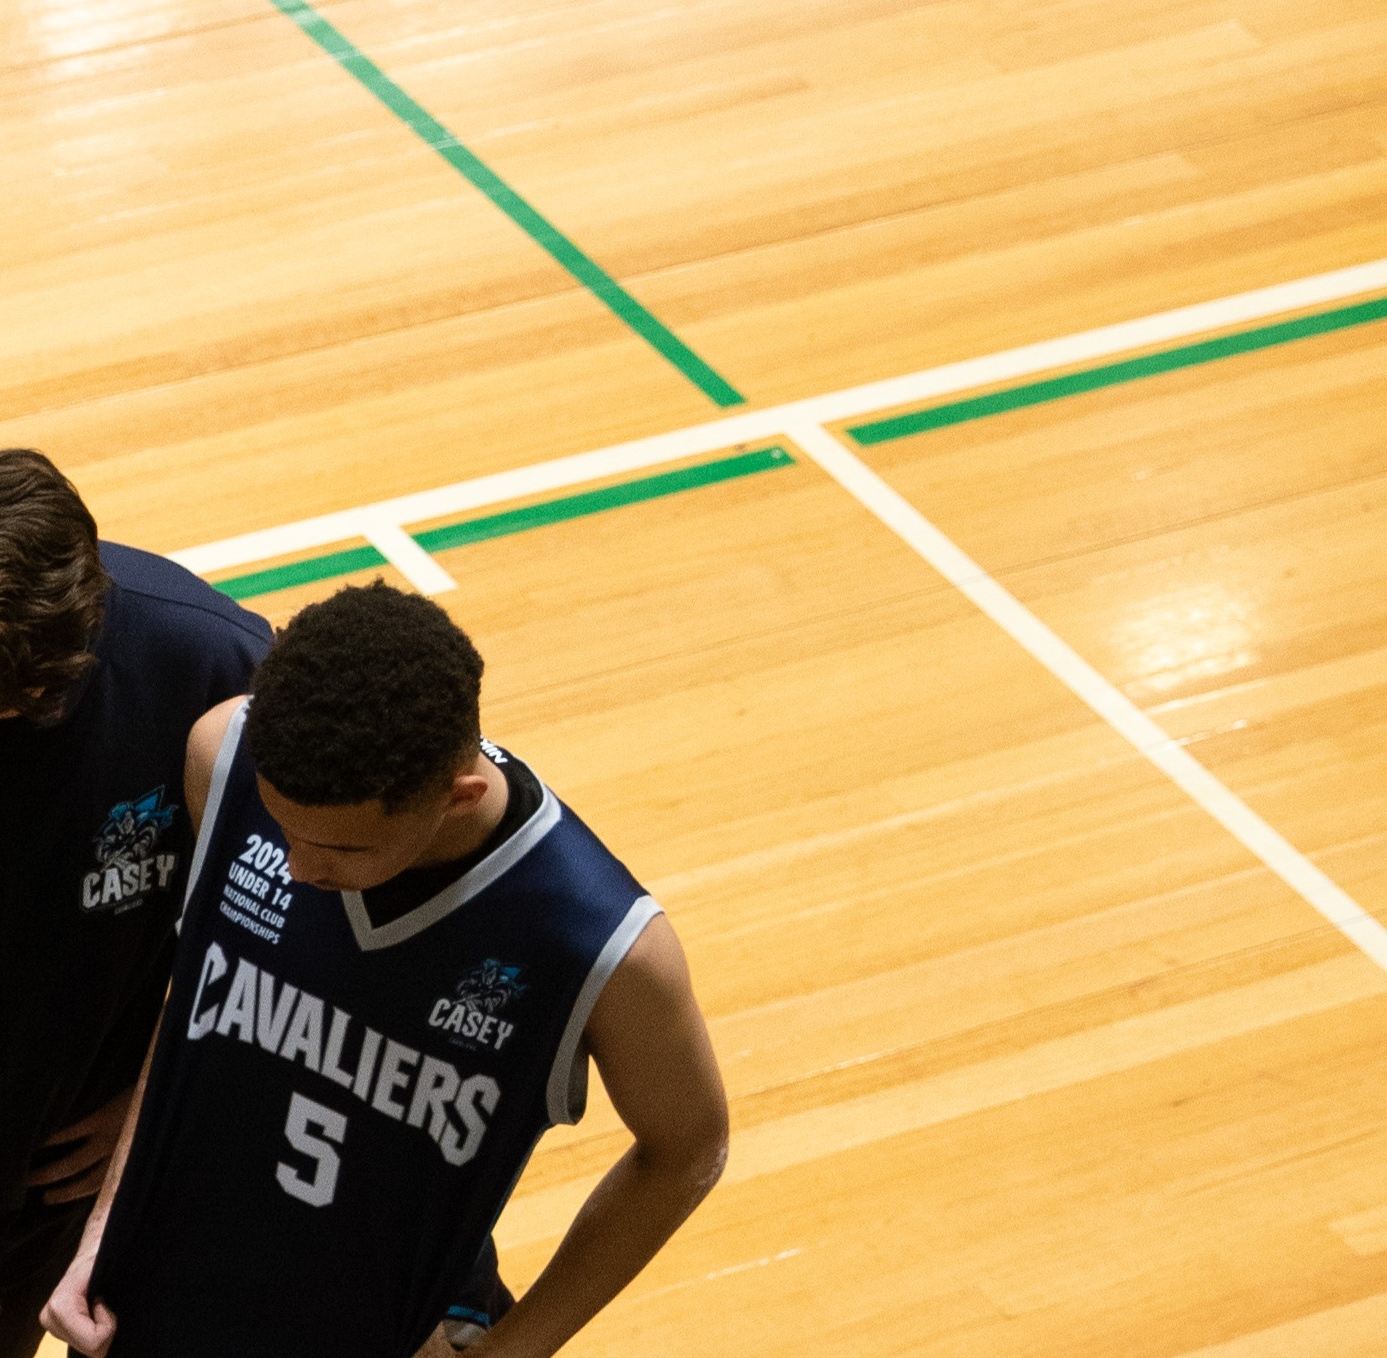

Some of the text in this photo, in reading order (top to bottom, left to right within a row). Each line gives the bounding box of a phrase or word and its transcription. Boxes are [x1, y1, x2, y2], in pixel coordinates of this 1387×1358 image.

[82, 853, 176, 909] CASEY
[228, 860, 294, 911] UNDER 14
[259, 907, 287, 929] CLUB
[428, 998, 515, 1051] CASEY
[187, 941, 503, 1167] CAVALIERS
[275, 1091, 348, 1208] 5
